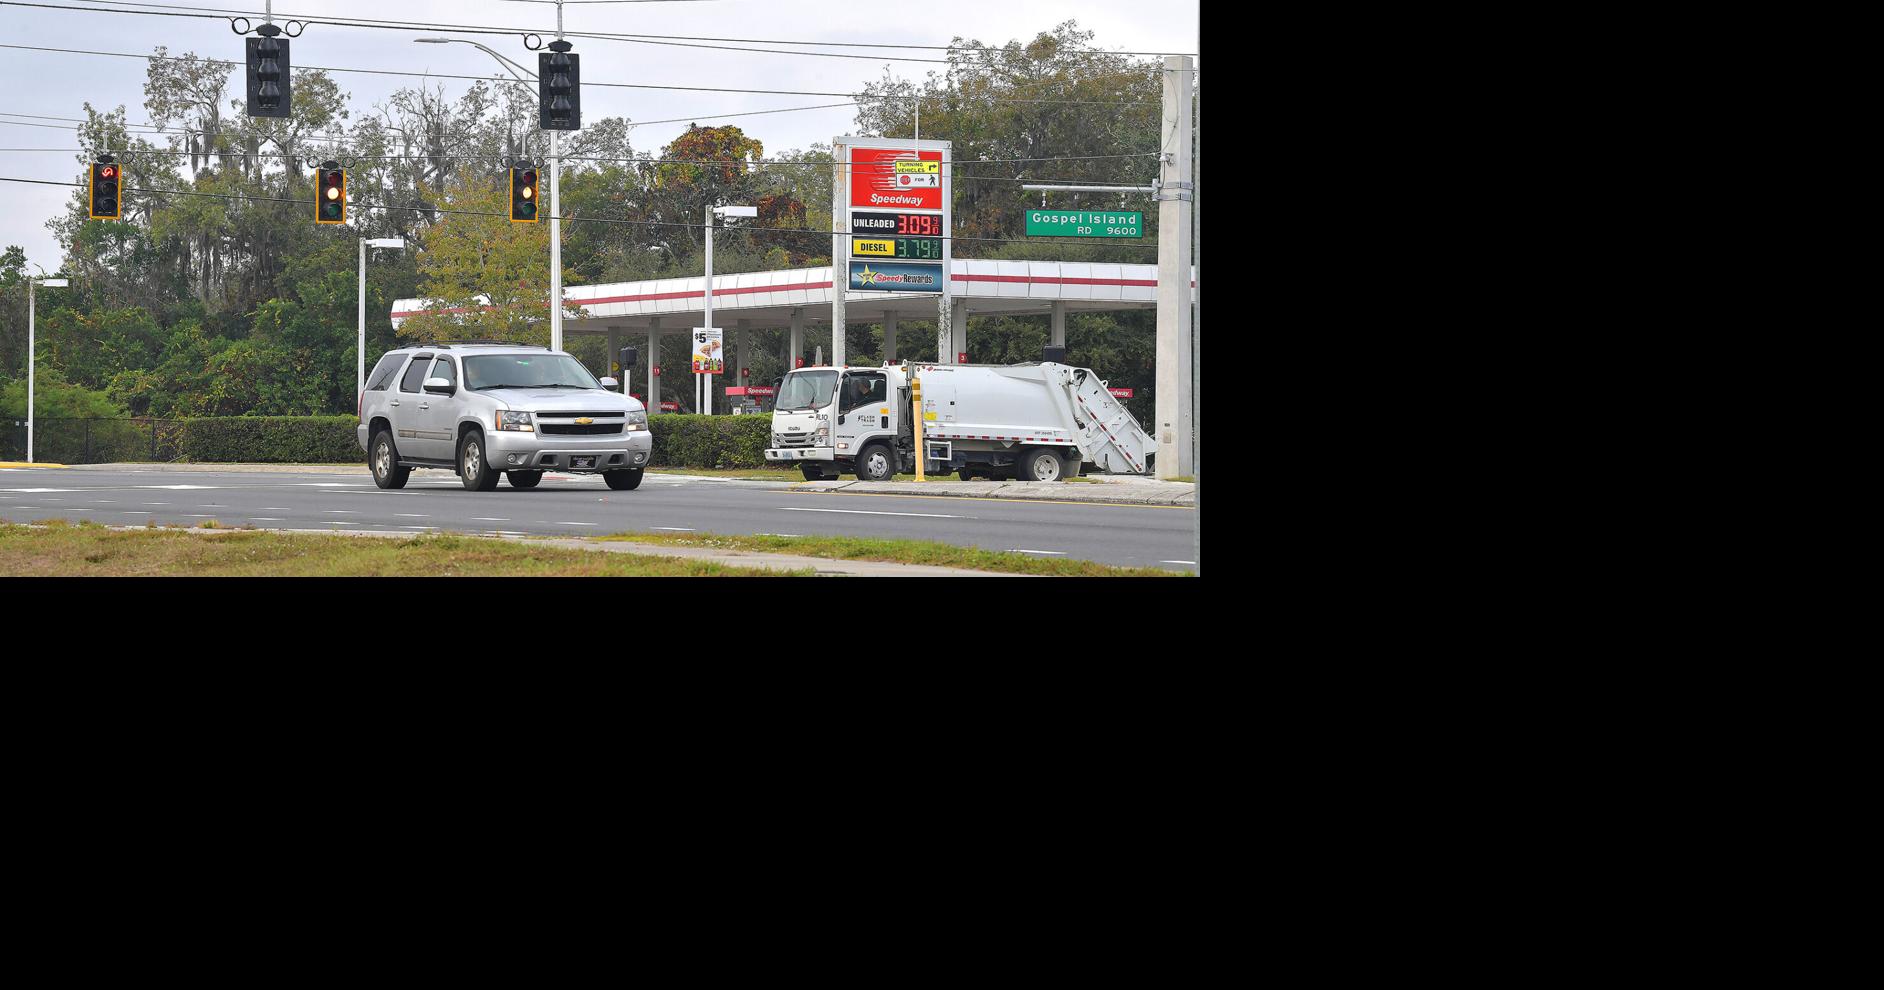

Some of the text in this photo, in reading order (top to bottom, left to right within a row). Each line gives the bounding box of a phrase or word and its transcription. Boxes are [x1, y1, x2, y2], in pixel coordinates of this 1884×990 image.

[870, 193, 923, 206] Speedway
[853, 215, 931, 235] UNLEADED 3.09
[1032, 212, 1136, 225] Gospel Island
[1077, 226, 1137, 235] RD 9600
[860, 239, 931, 258] DIESEL 3.79
[694, 332, 707, 344] $5
